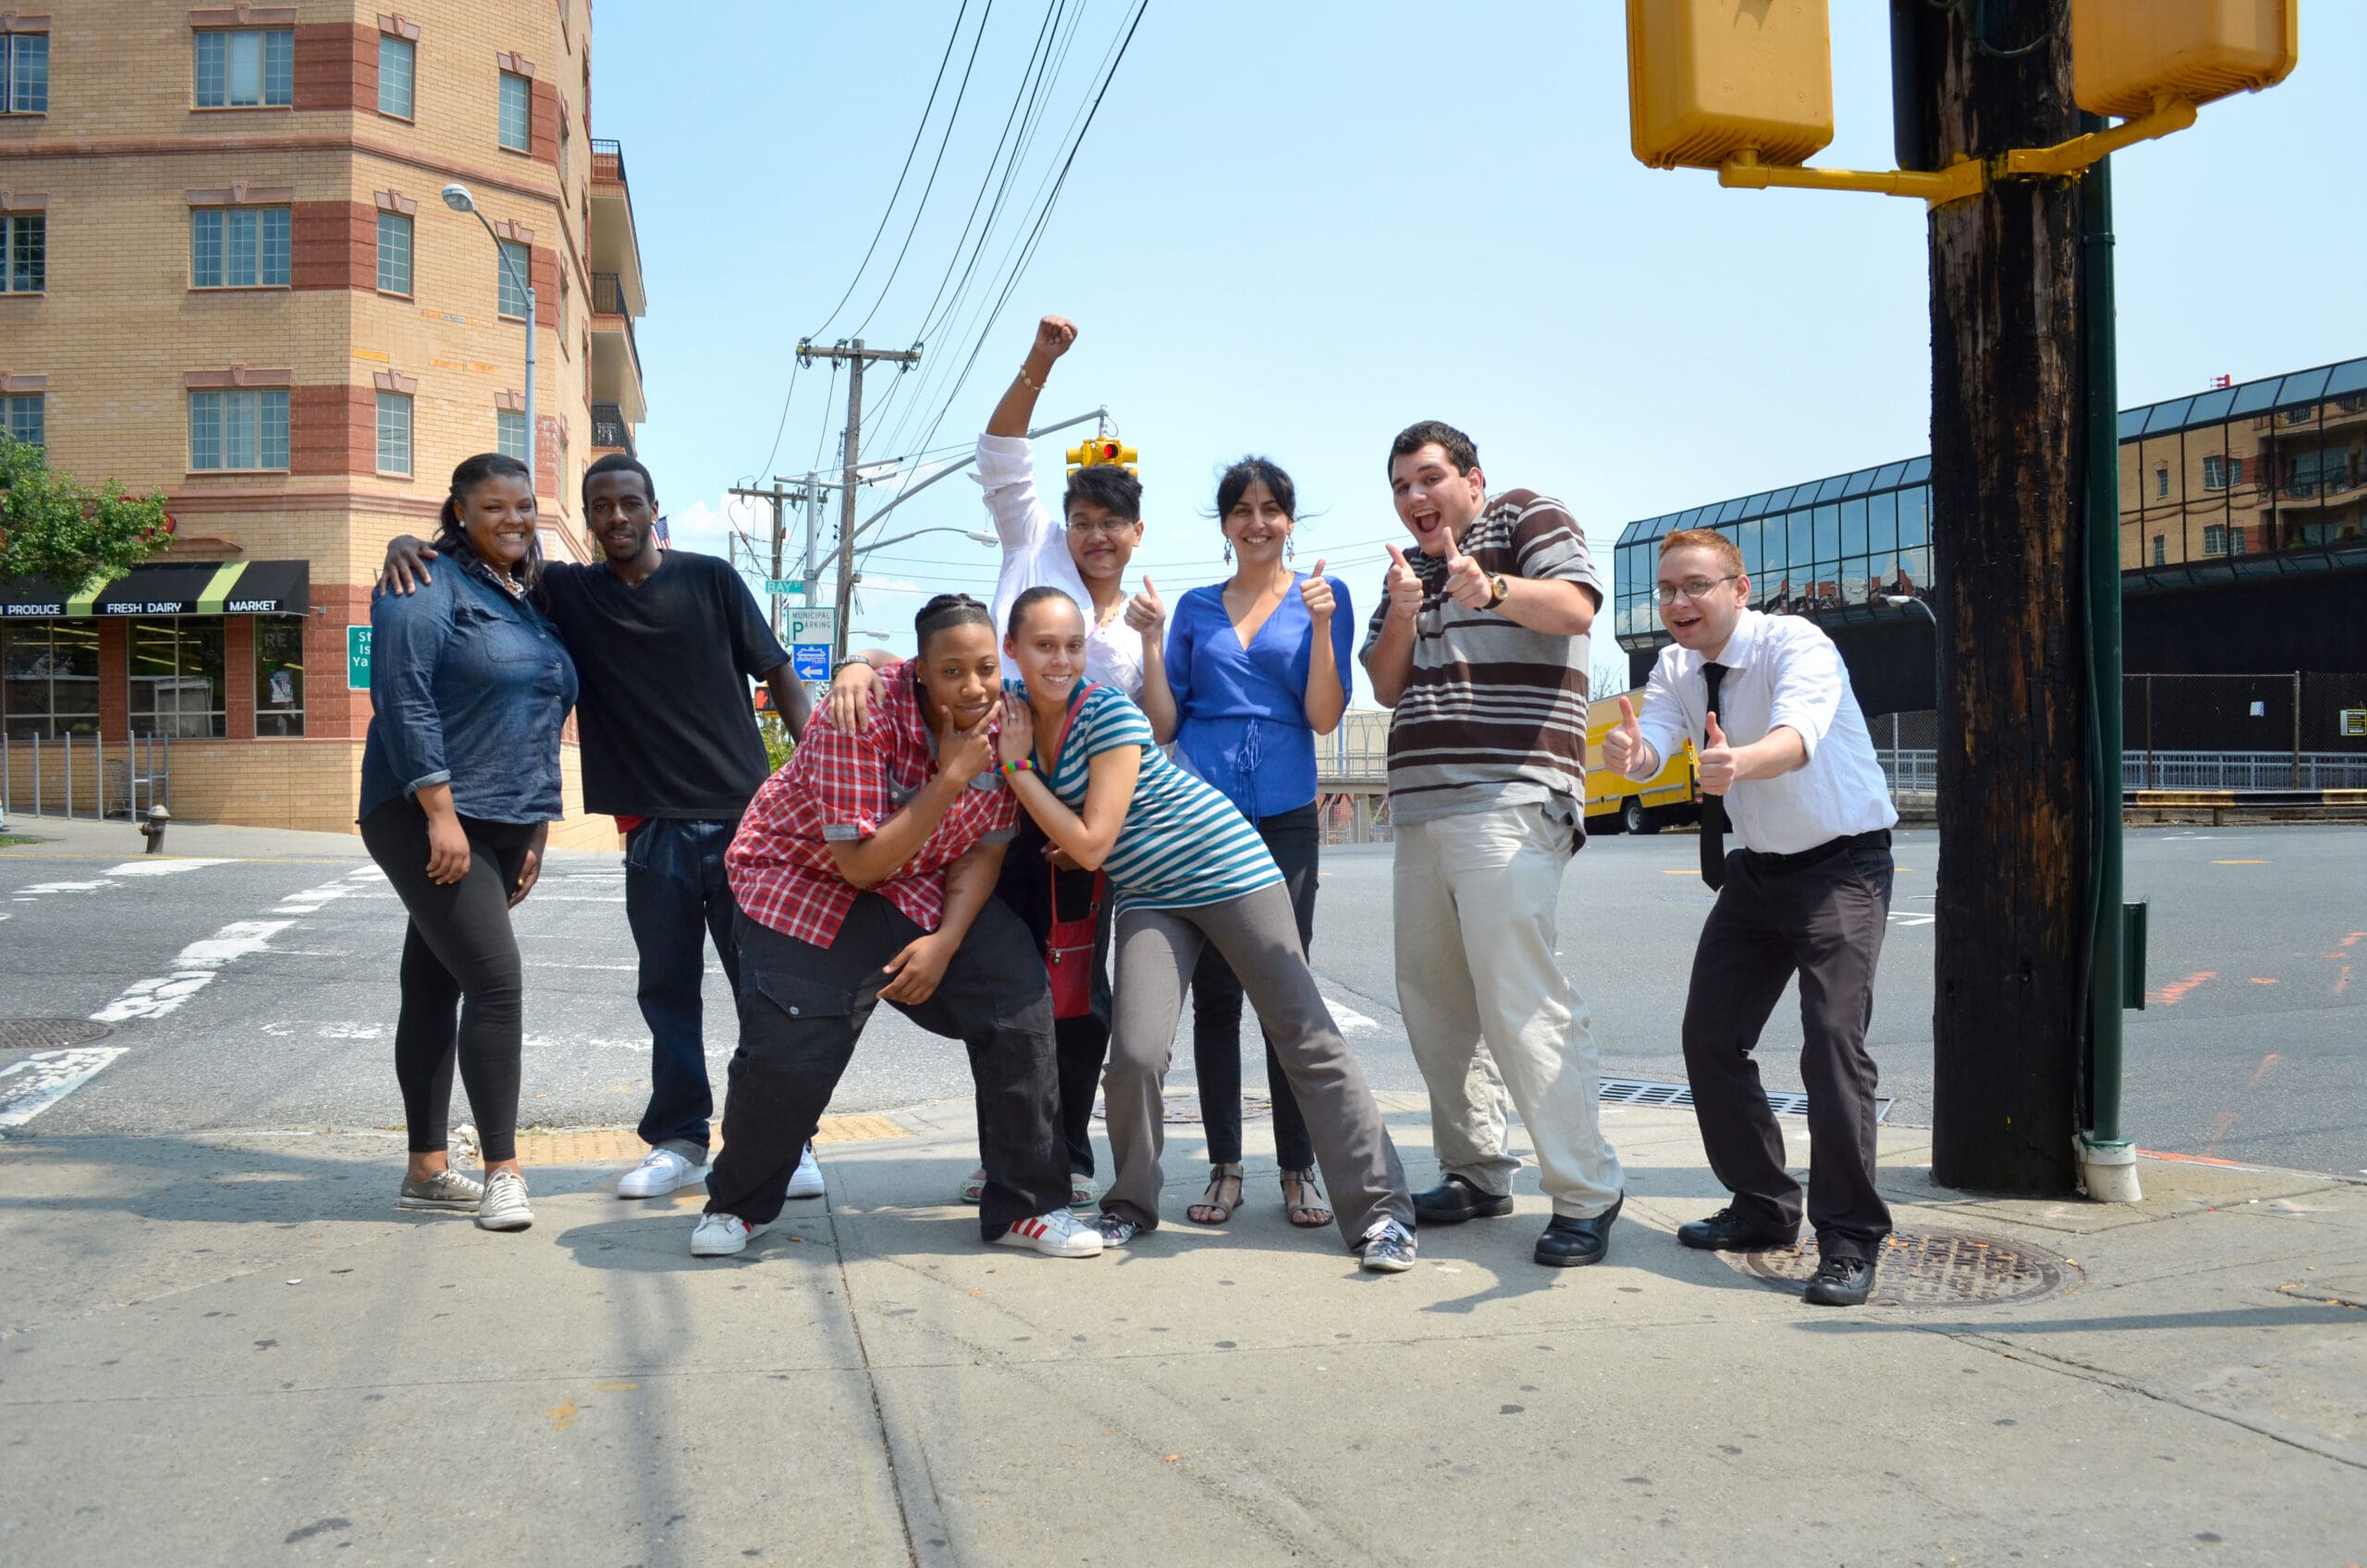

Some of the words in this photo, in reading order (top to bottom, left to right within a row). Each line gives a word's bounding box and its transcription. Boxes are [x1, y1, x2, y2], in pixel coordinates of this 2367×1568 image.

[767, 582, 792, 592] BAY
[7, 604, 61, 615] PRODUCE
[107, 603, 142, 613] FRESH
[147, 602, 182, 613] DAIRY
[229, 600, 276, 612] MARKET
[791, 611, 830, 619] MUNICIPAL
